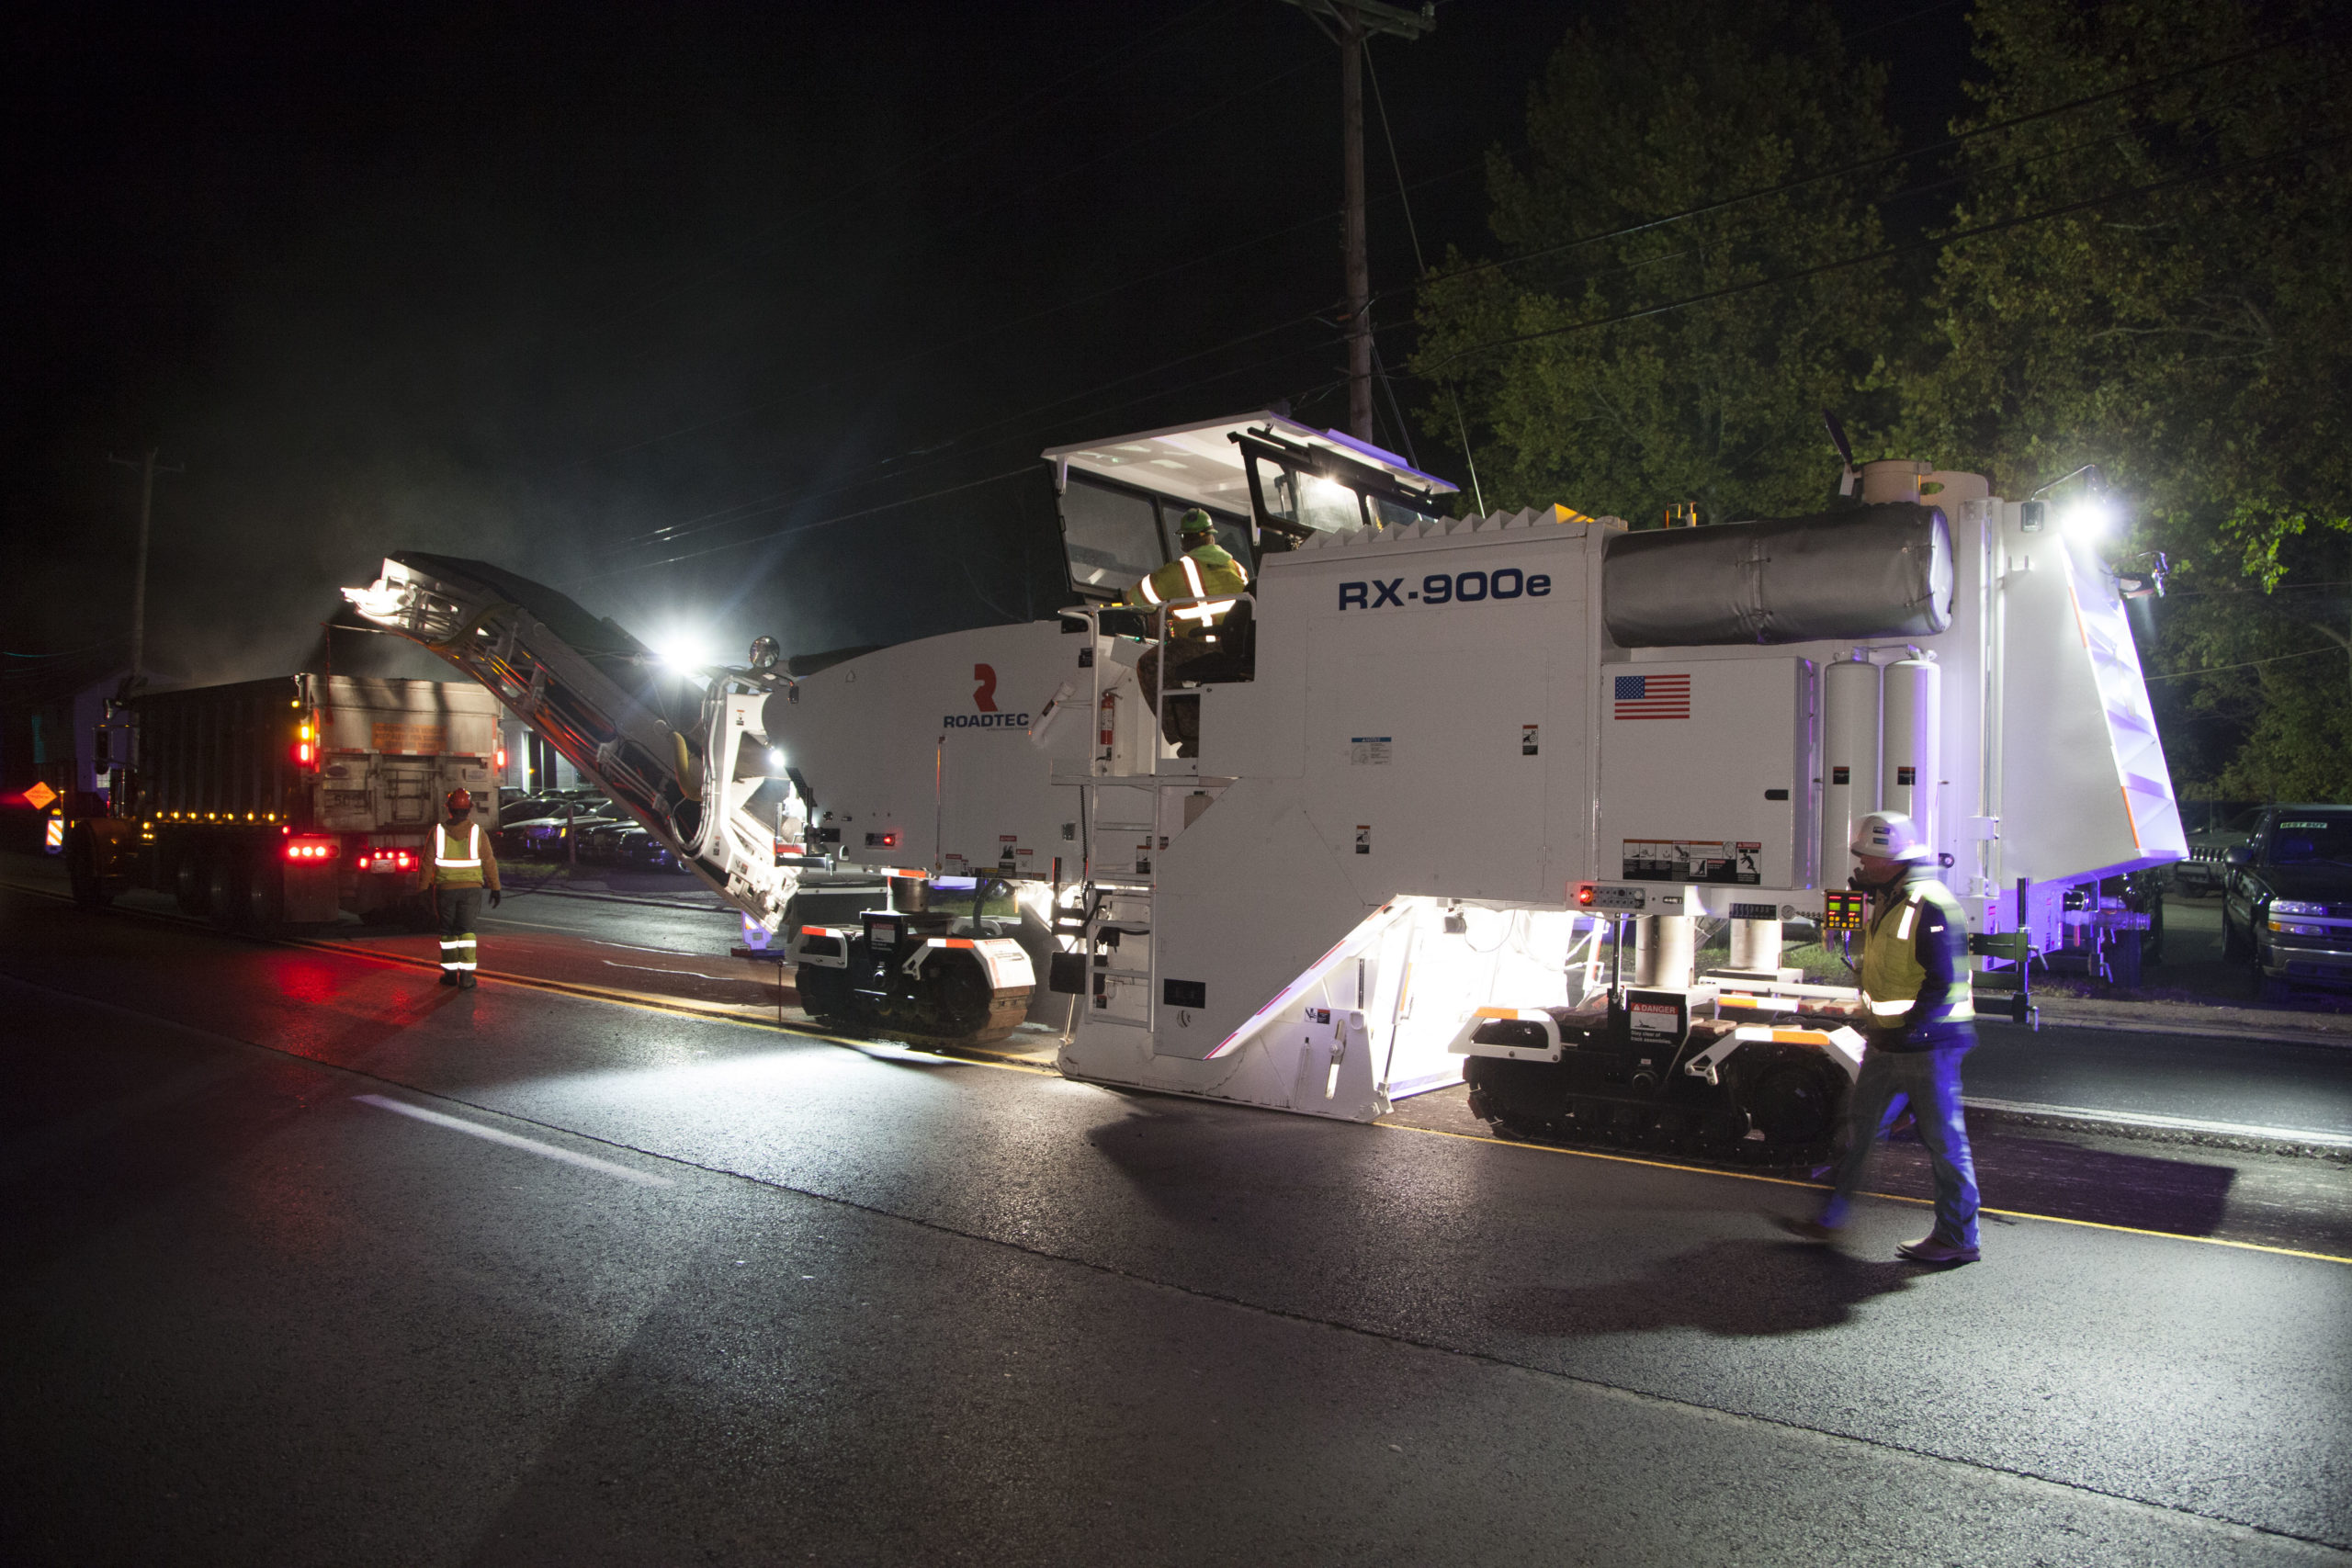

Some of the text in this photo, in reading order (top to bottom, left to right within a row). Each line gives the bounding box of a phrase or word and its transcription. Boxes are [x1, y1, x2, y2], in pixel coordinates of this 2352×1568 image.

[1339, 568, 1552, 611] RX-900e
[944, 713, 1029, 728] ROADTEC
[1641, 1004, 1676, 1014] DANGER
